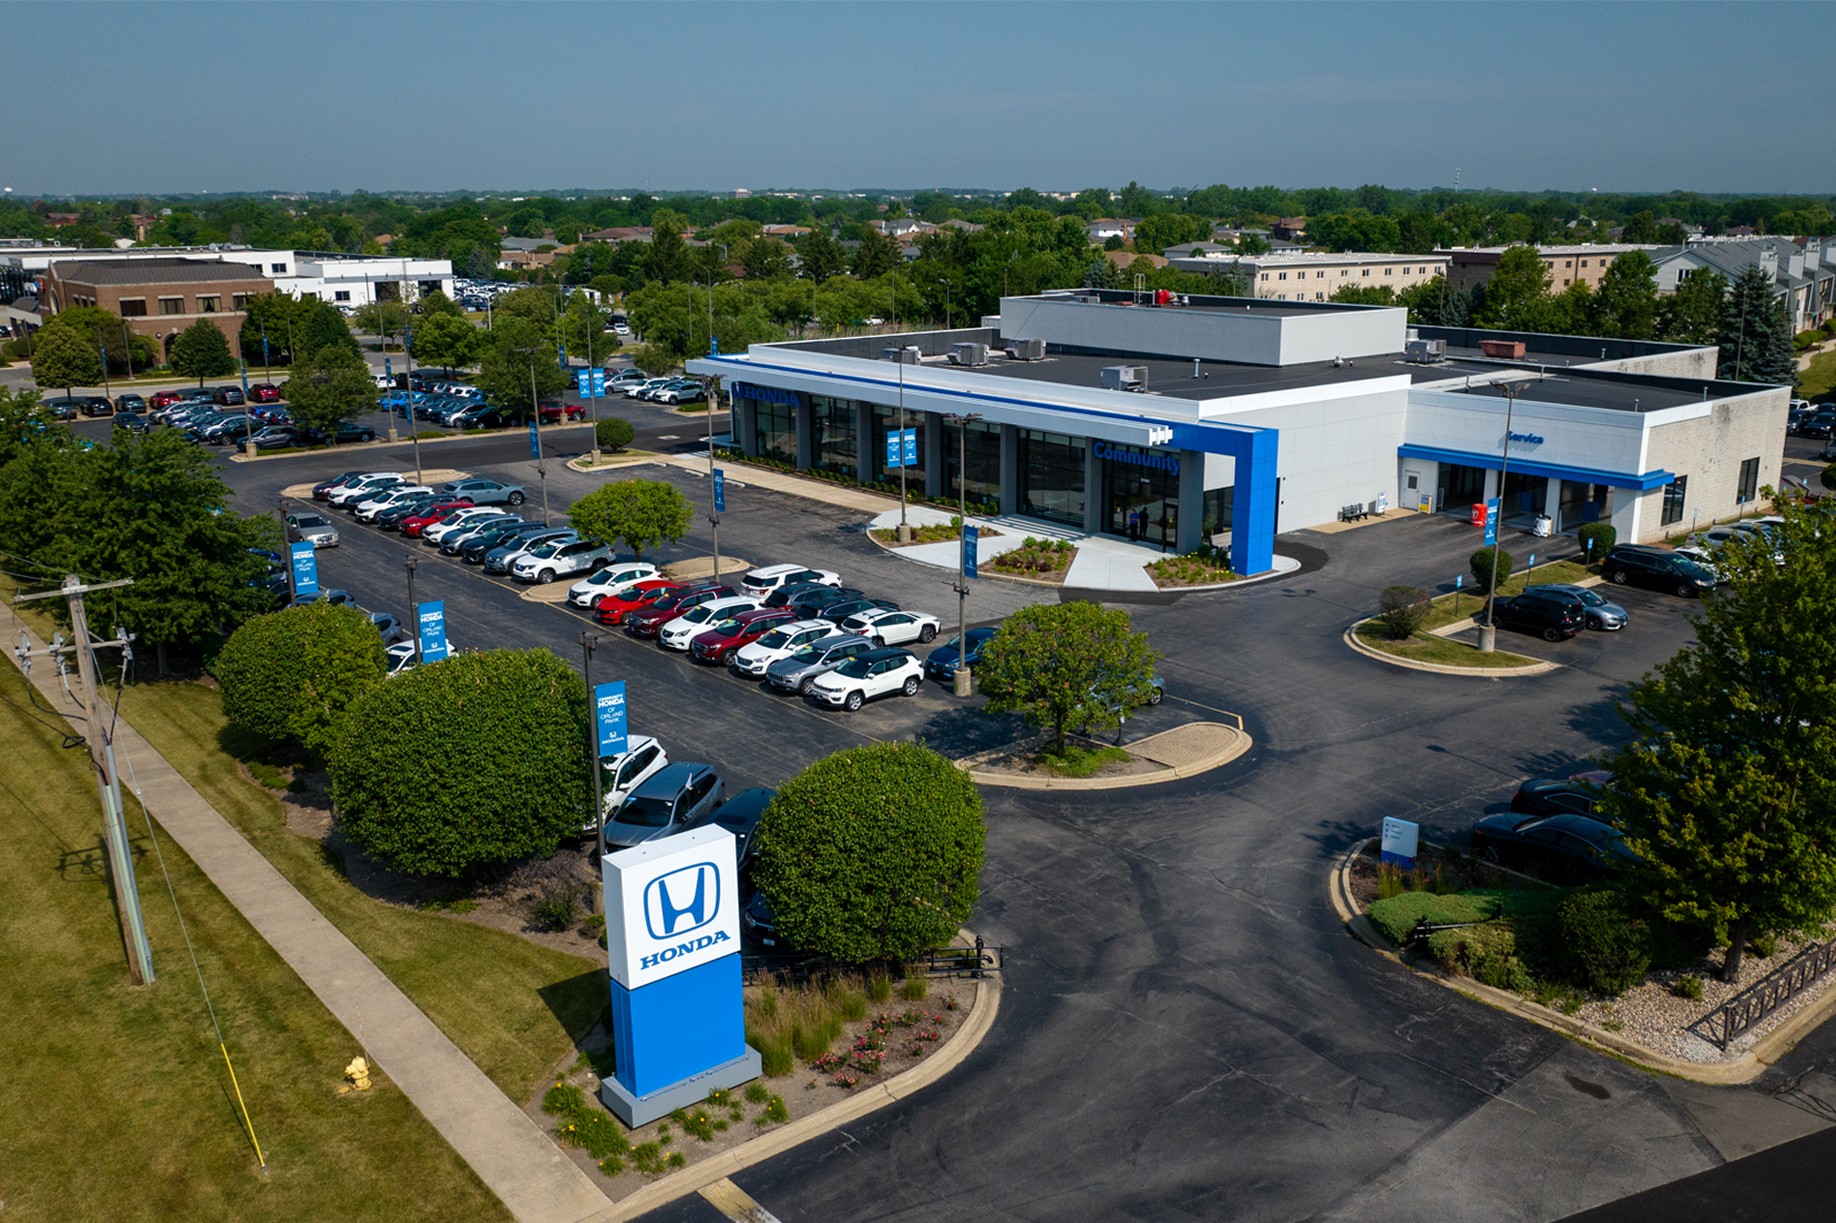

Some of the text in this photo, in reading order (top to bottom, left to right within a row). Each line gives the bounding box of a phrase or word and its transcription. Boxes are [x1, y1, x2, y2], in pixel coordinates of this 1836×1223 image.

[743, 386, 802, 407] HONDA
[1094, 441, 1180, 476] Community
[420, 614, 443, 623] HONDA
[598, 698, 624, 708] HONDA
[600, 711, 623, 720] ORLAND
[604, 717, 620, 725] PARK
[602, 737, 625, 745] HONDA
[640, 930, 731, 971] HONDA
